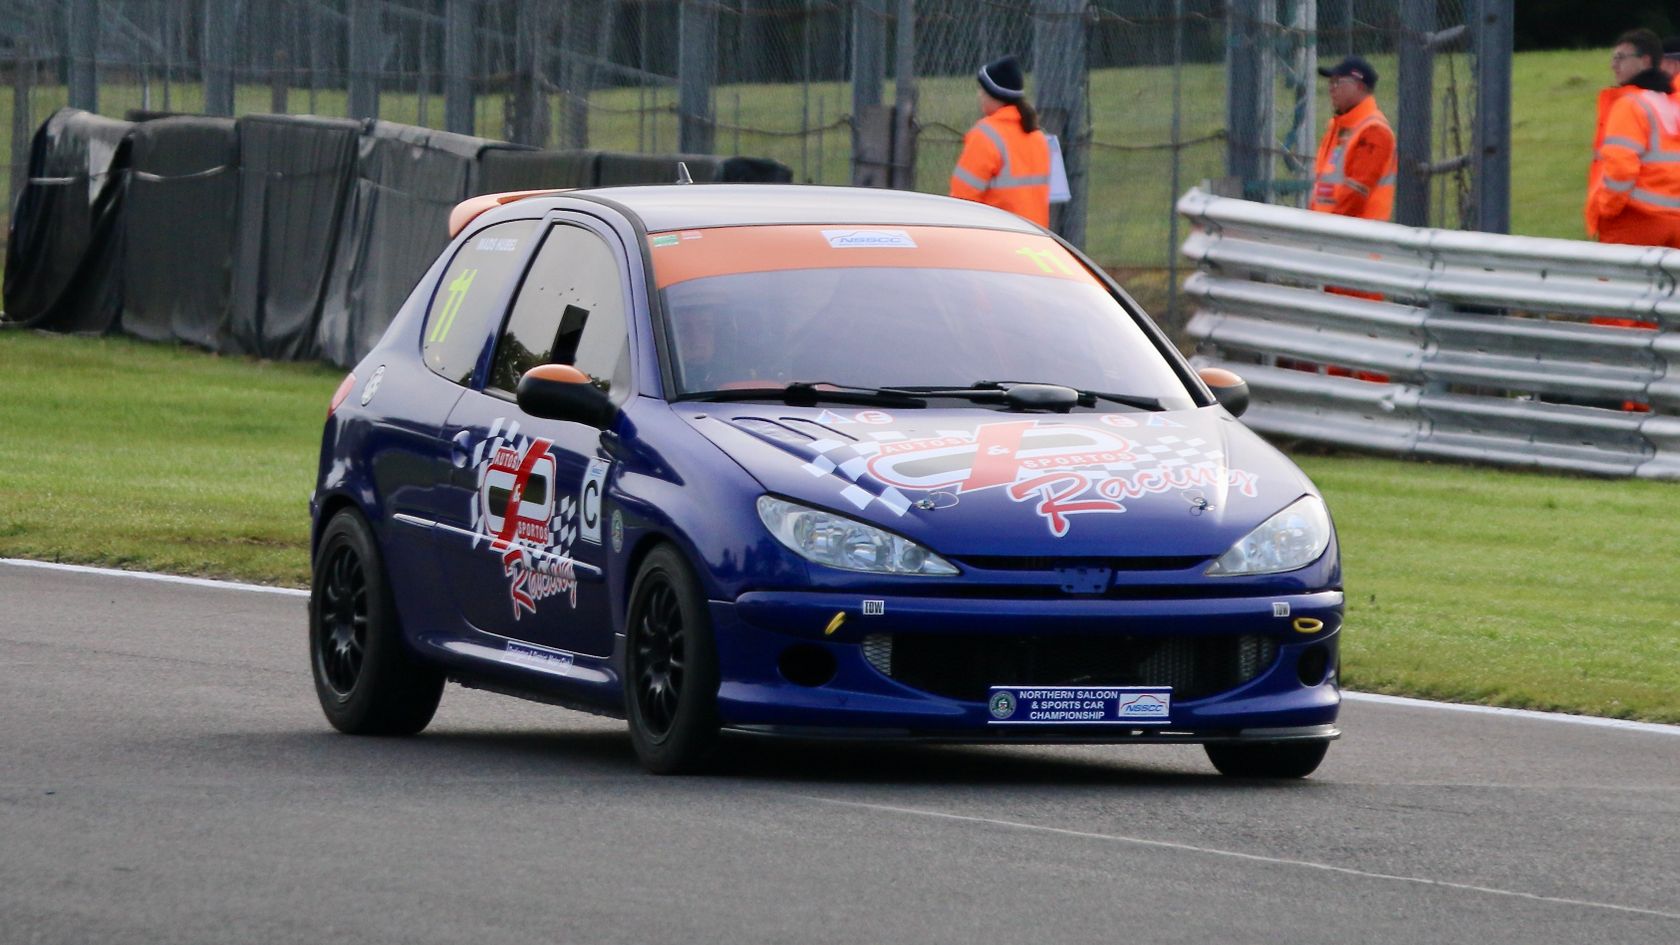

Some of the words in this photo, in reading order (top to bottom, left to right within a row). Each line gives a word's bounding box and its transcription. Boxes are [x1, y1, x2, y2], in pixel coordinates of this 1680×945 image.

[1015, 247, 1073, 276] 11
[429, 268, 477, 342] 11
[1021, 451, 1134, 470] SPORTOS
[583, 479, 599, 529] C
[1006, 463, 1259, 538] Racing
[517, 520, 550, 541] SPORTOS
[864, 601, 883, 614] TOW
[1019, 690, 1075, 699] NORTHERN
[1077, 690, 1118, 699] SALOON
[1031, 701, 1038, 709] &
[1040, 701, 1081, 710] SPORTS
[1083, 701, 1104, 709] CAR
[1125, 704, 1164, 712] NSSCC
[1030, 711, 1105, 720] CHAMPIONSHIP
